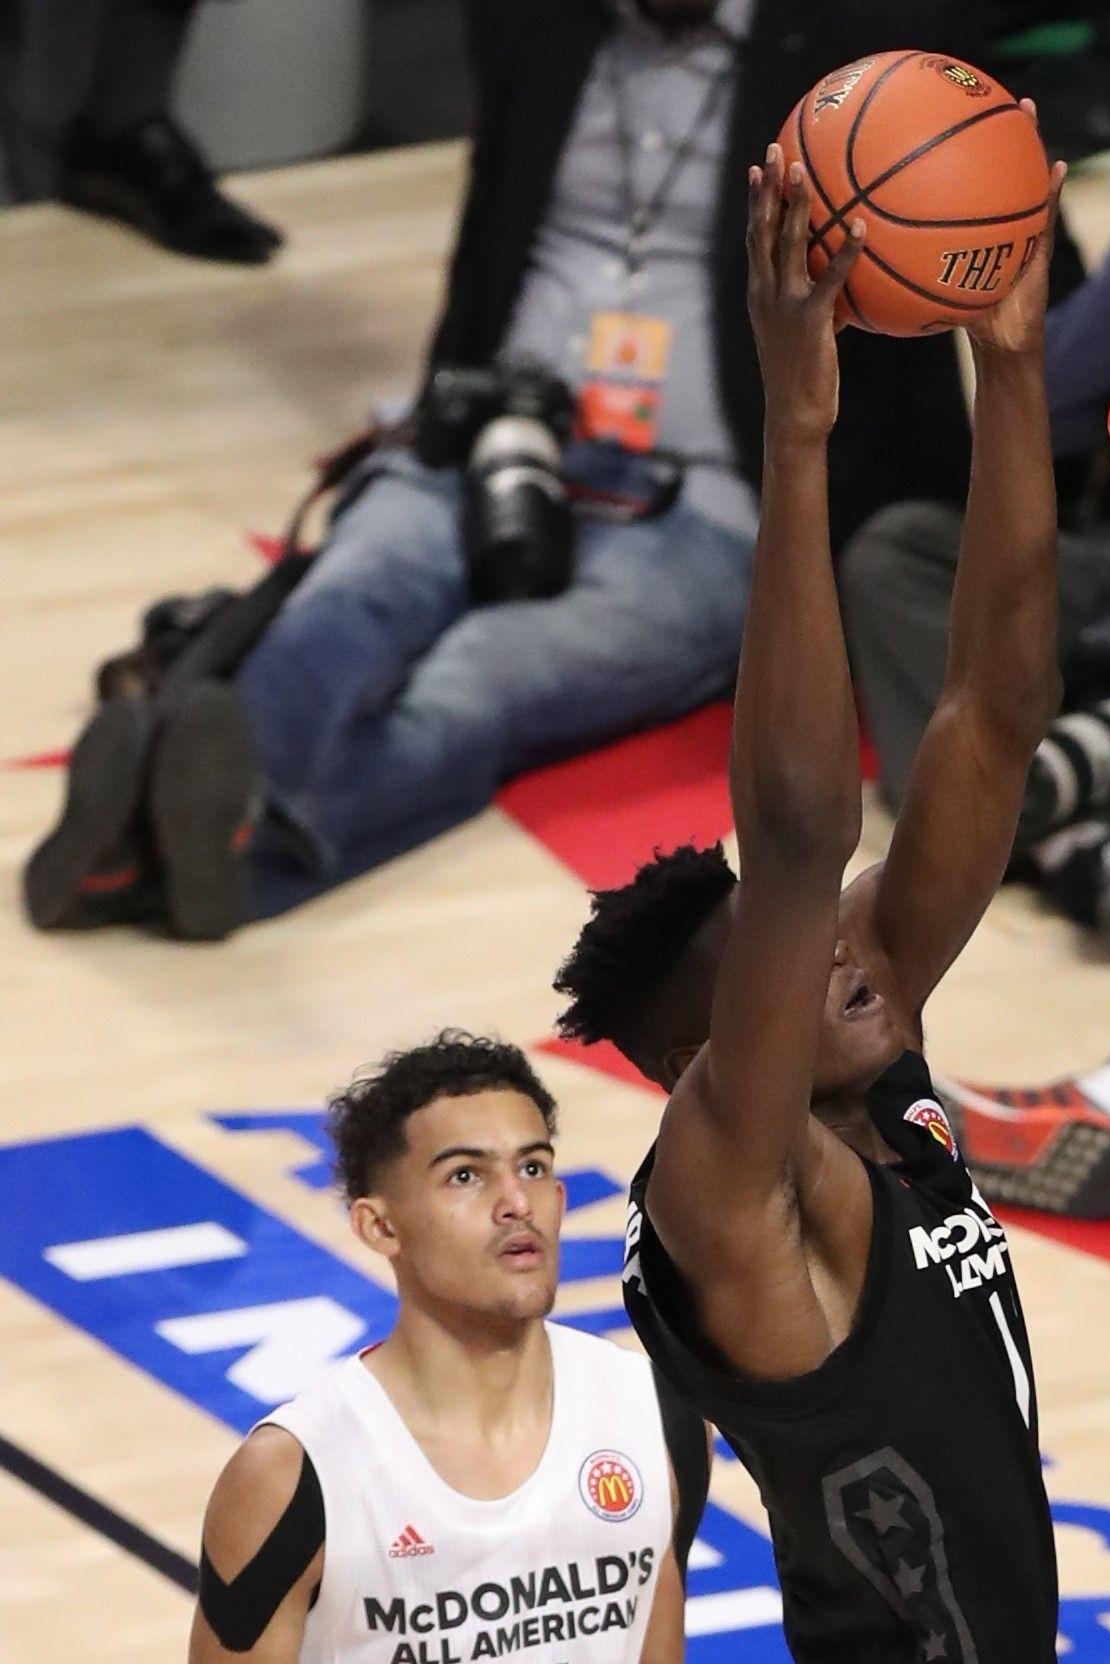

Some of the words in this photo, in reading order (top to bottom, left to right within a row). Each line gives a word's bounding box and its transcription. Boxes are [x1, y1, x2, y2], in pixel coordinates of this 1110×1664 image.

[937, 242, 1014, 291] THE
[388, 1543, 435, 1559] adidas
[364, 1547, 655, 1635] McDONALD'S
[471, 1596, 638, 1661] AMERICAN
